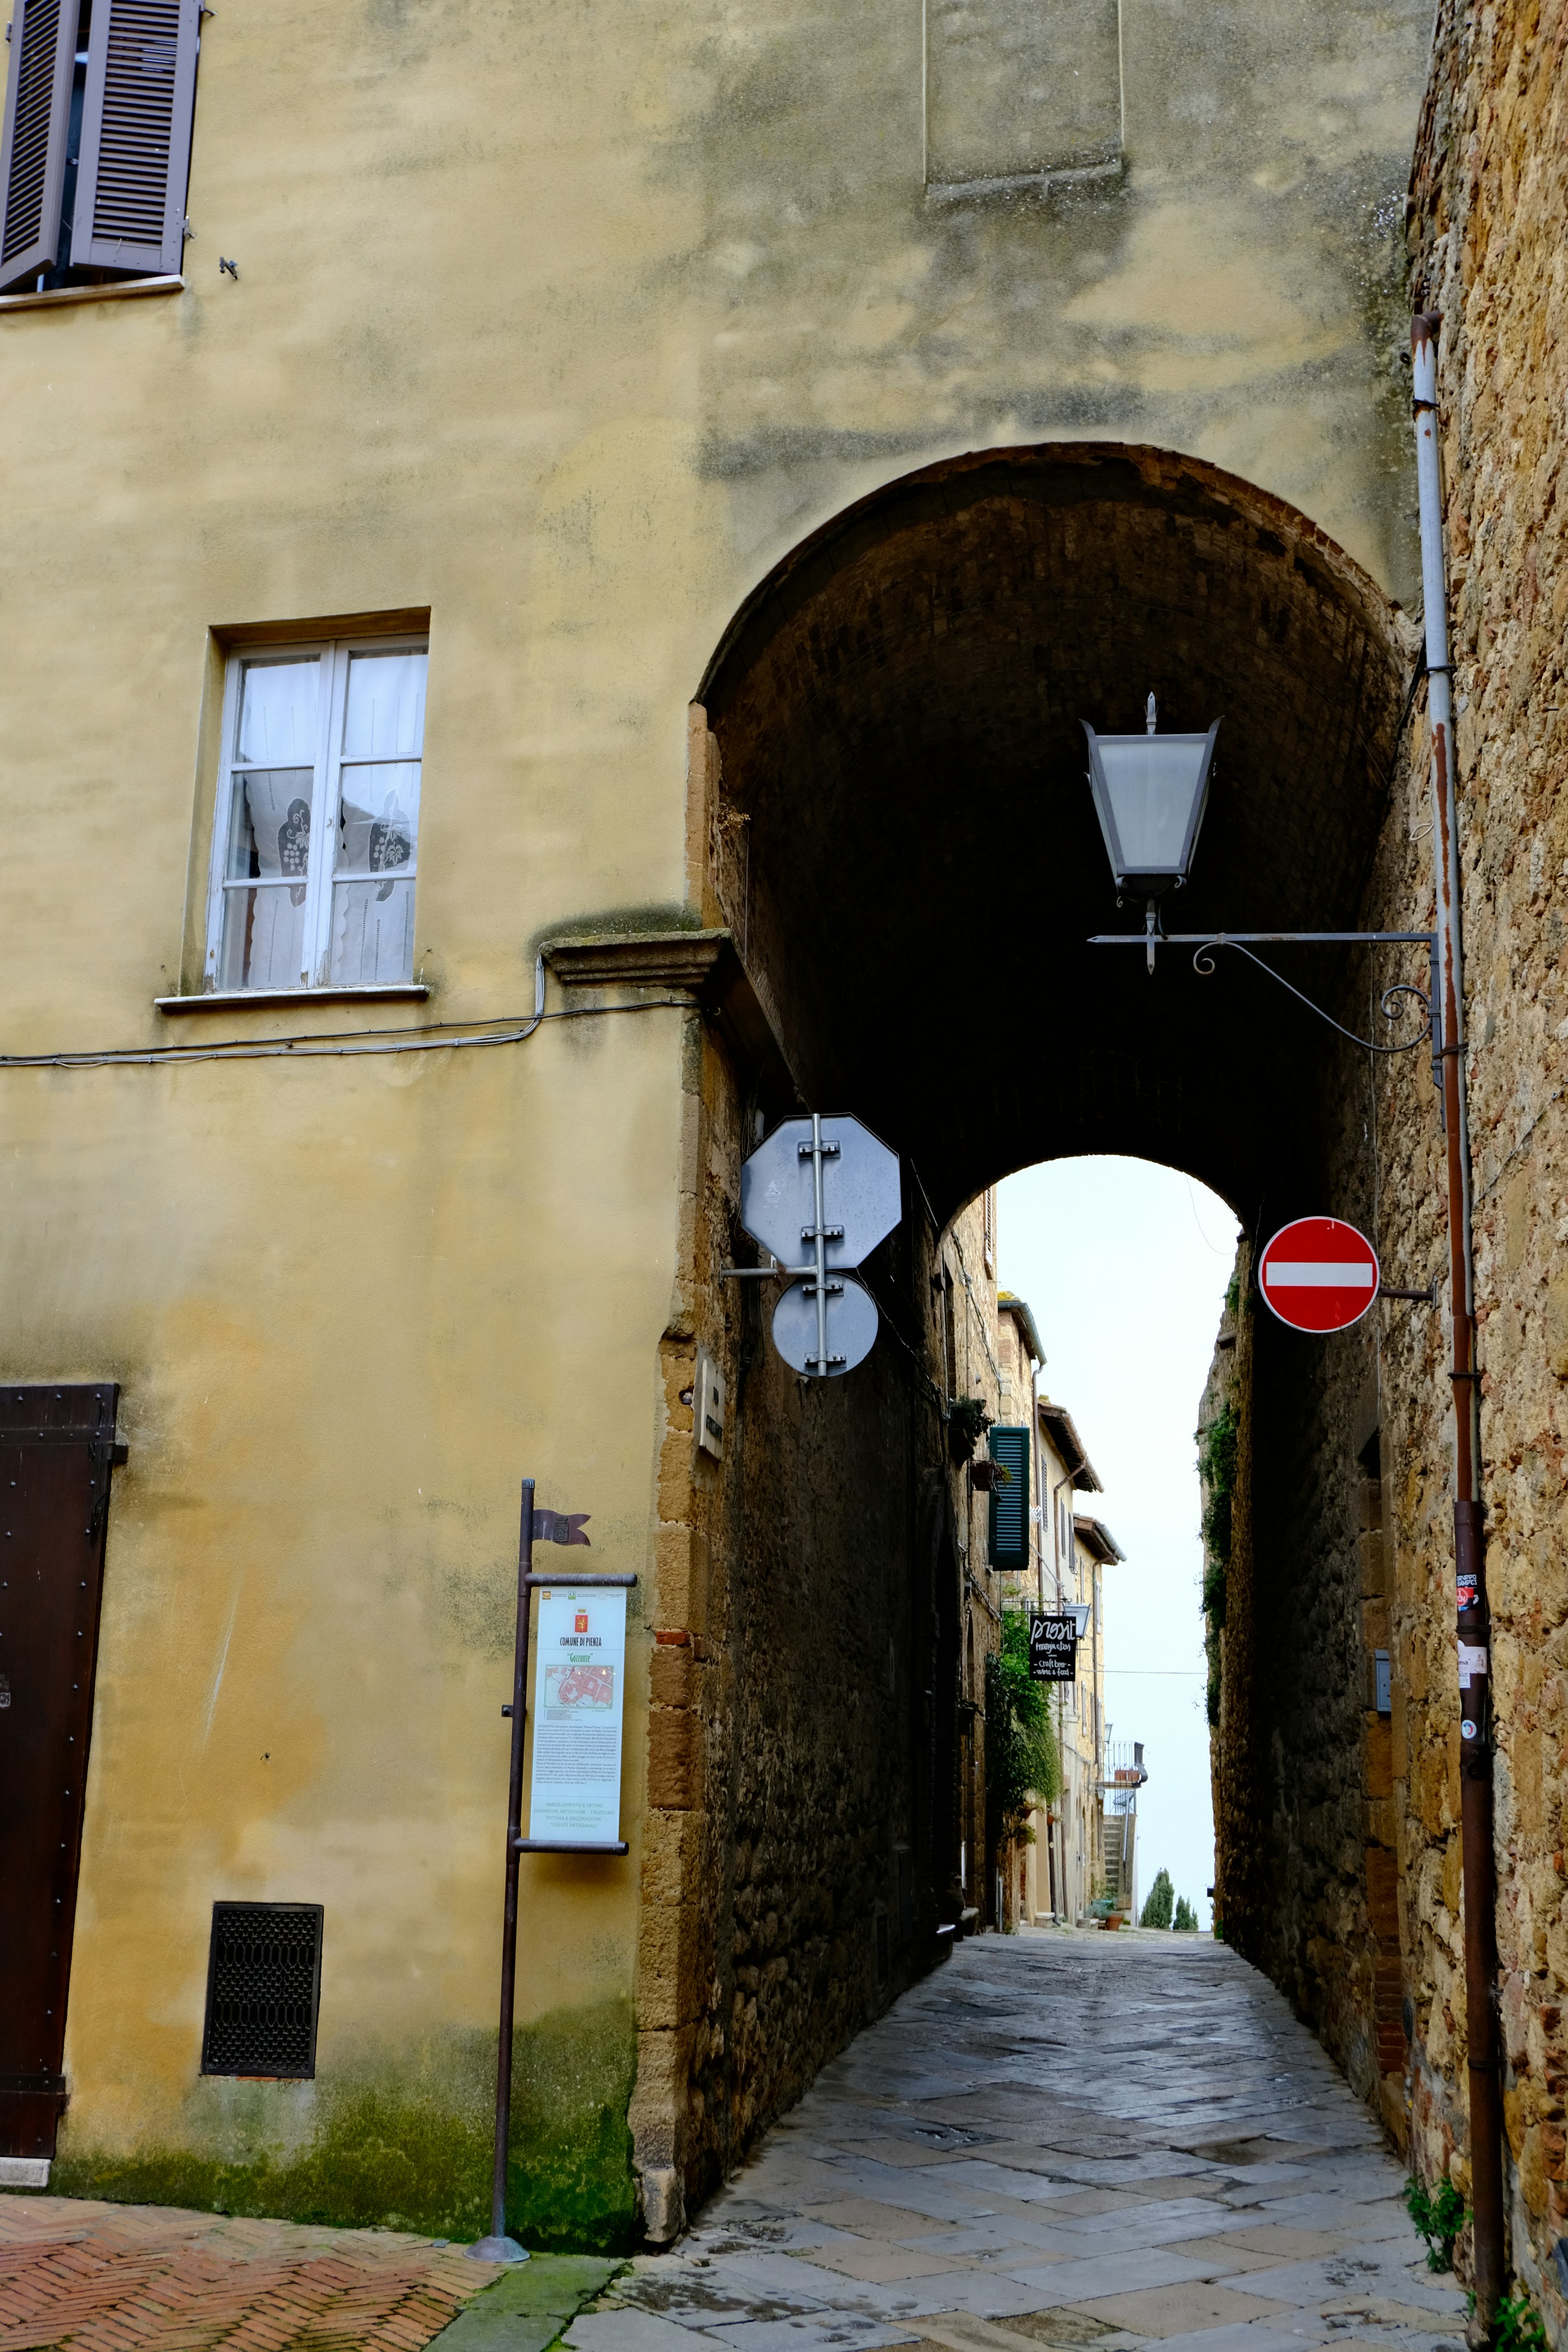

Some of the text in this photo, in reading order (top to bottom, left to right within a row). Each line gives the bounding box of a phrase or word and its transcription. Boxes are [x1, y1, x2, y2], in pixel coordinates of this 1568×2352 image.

[560, 1637, 602, 1646] COMUNE DI PIENZA
[1054, 1659, 1067, 1668] beer
[1057, 1668, 1069, 1676] food
